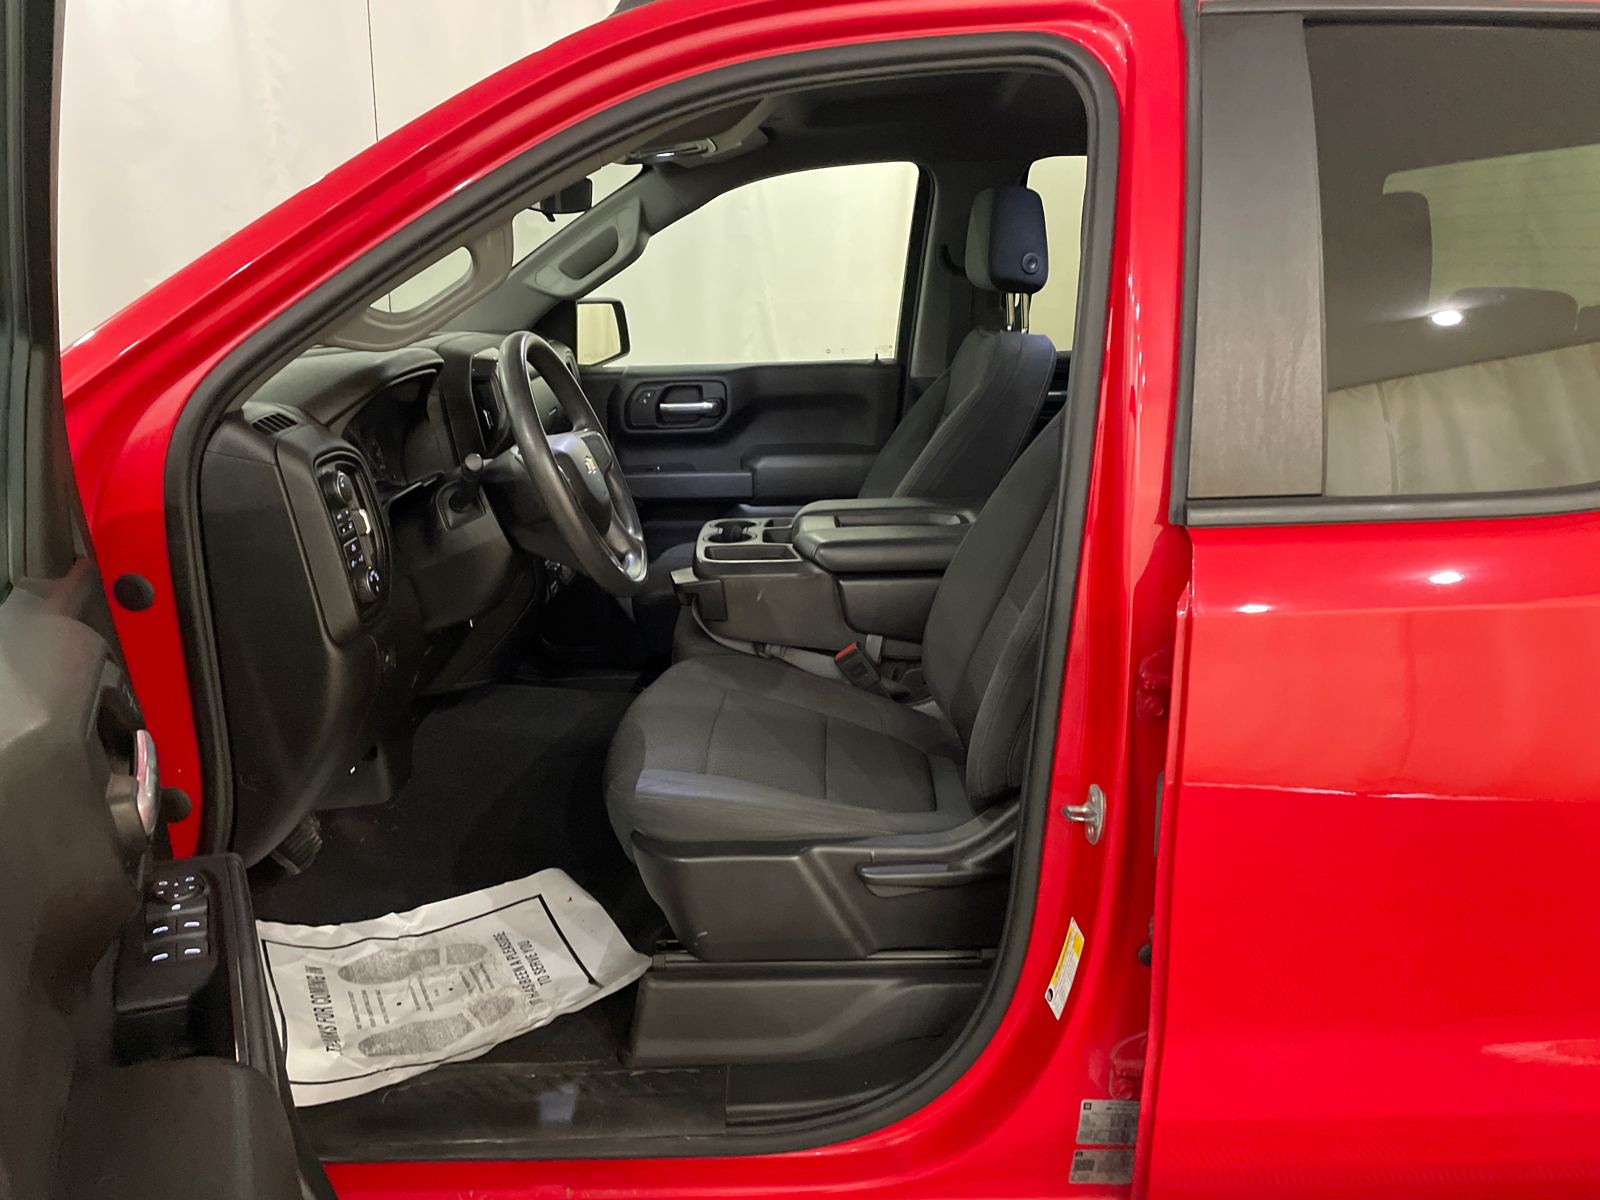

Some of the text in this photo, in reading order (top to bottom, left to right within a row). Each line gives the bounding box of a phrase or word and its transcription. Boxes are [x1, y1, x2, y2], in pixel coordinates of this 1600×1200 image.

[493, 931, 519, 961] PLEASURE
[512, 965, 532, 985] BEEN
[517, 940, 552, 986] TO SERVE YOU
[306, 975, 331, 1006] COMING
[522, 984, 540, 999] HAS
[313, 1007, 336, 1024] FOR
